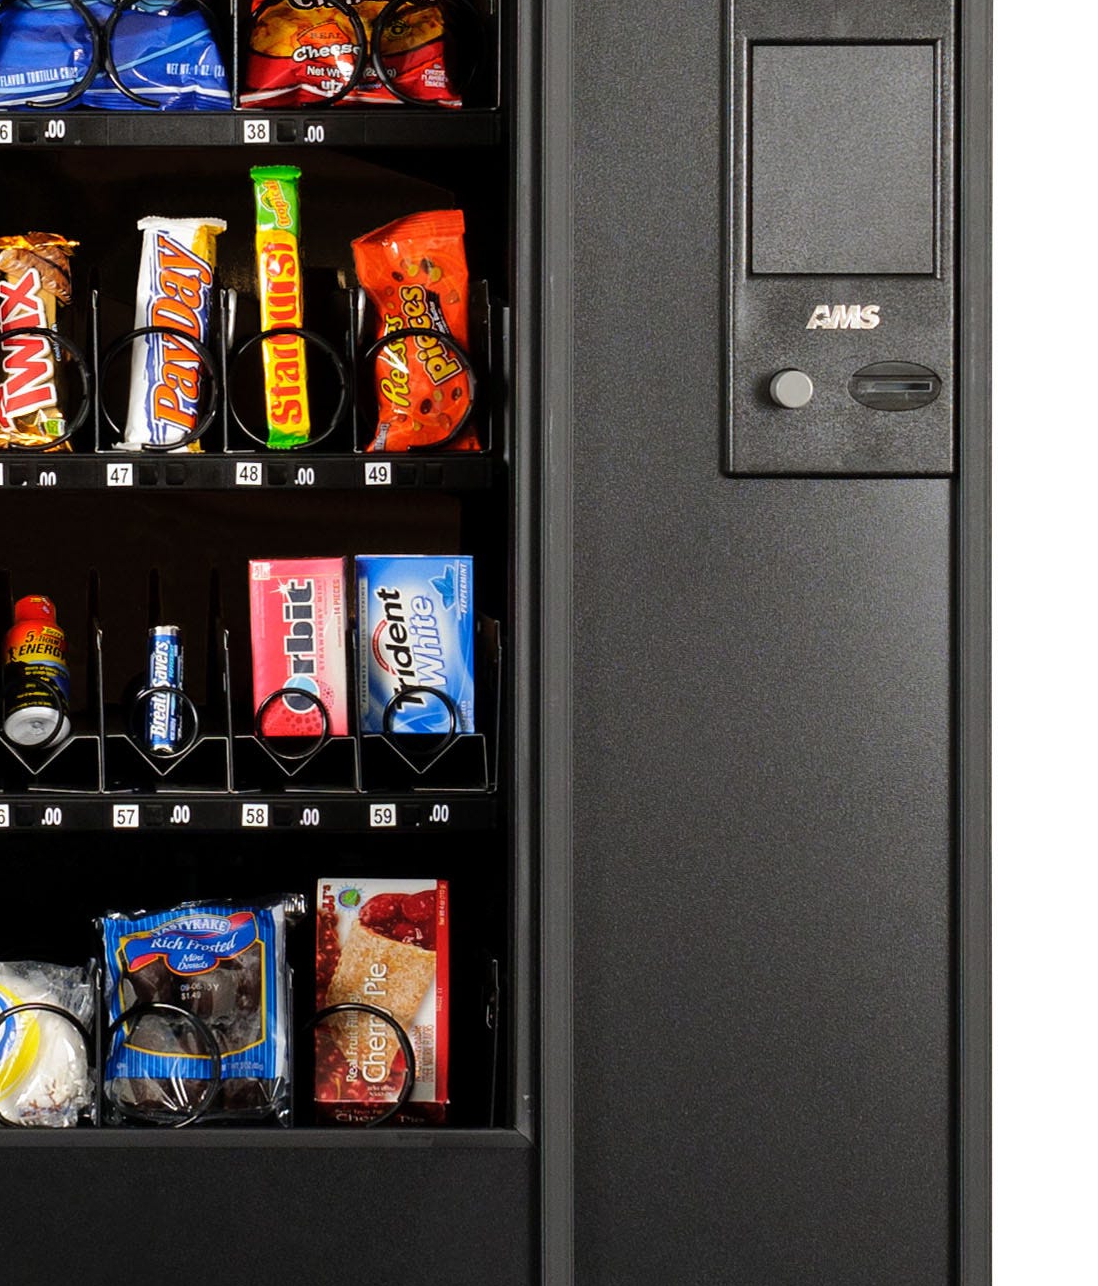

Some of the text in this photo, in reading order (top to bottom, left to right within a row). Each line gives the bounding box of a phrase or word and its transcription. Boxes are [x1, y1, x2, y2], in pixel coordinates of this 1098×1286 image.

[247, 124, 266, 140] 38
[304, 125, 324, 142] .00
[805, 304, 881, 330] AMS
[110, 468, 129, 483] 47
[240, 466, 258, 481] 48
[294, 468, 314, 485] .00
[368, 466, 387, 482] 49
[377, 587, 425, 711] Trident
[410, 595, 448, 688] White
[152, 640, 171, 687] Savers
[116, 809, 135, 823] 57
[170, 805, 190, 823] .00
[246, 809, 265, 824] 58
[374, 809, 393, 824] 59
[429, 804, 449, 822] .00
[150, 932, 239, 952] Rich Frosted
[364, 963, 388, 996] Pie
[346, 1059, 358, 1083] Real
